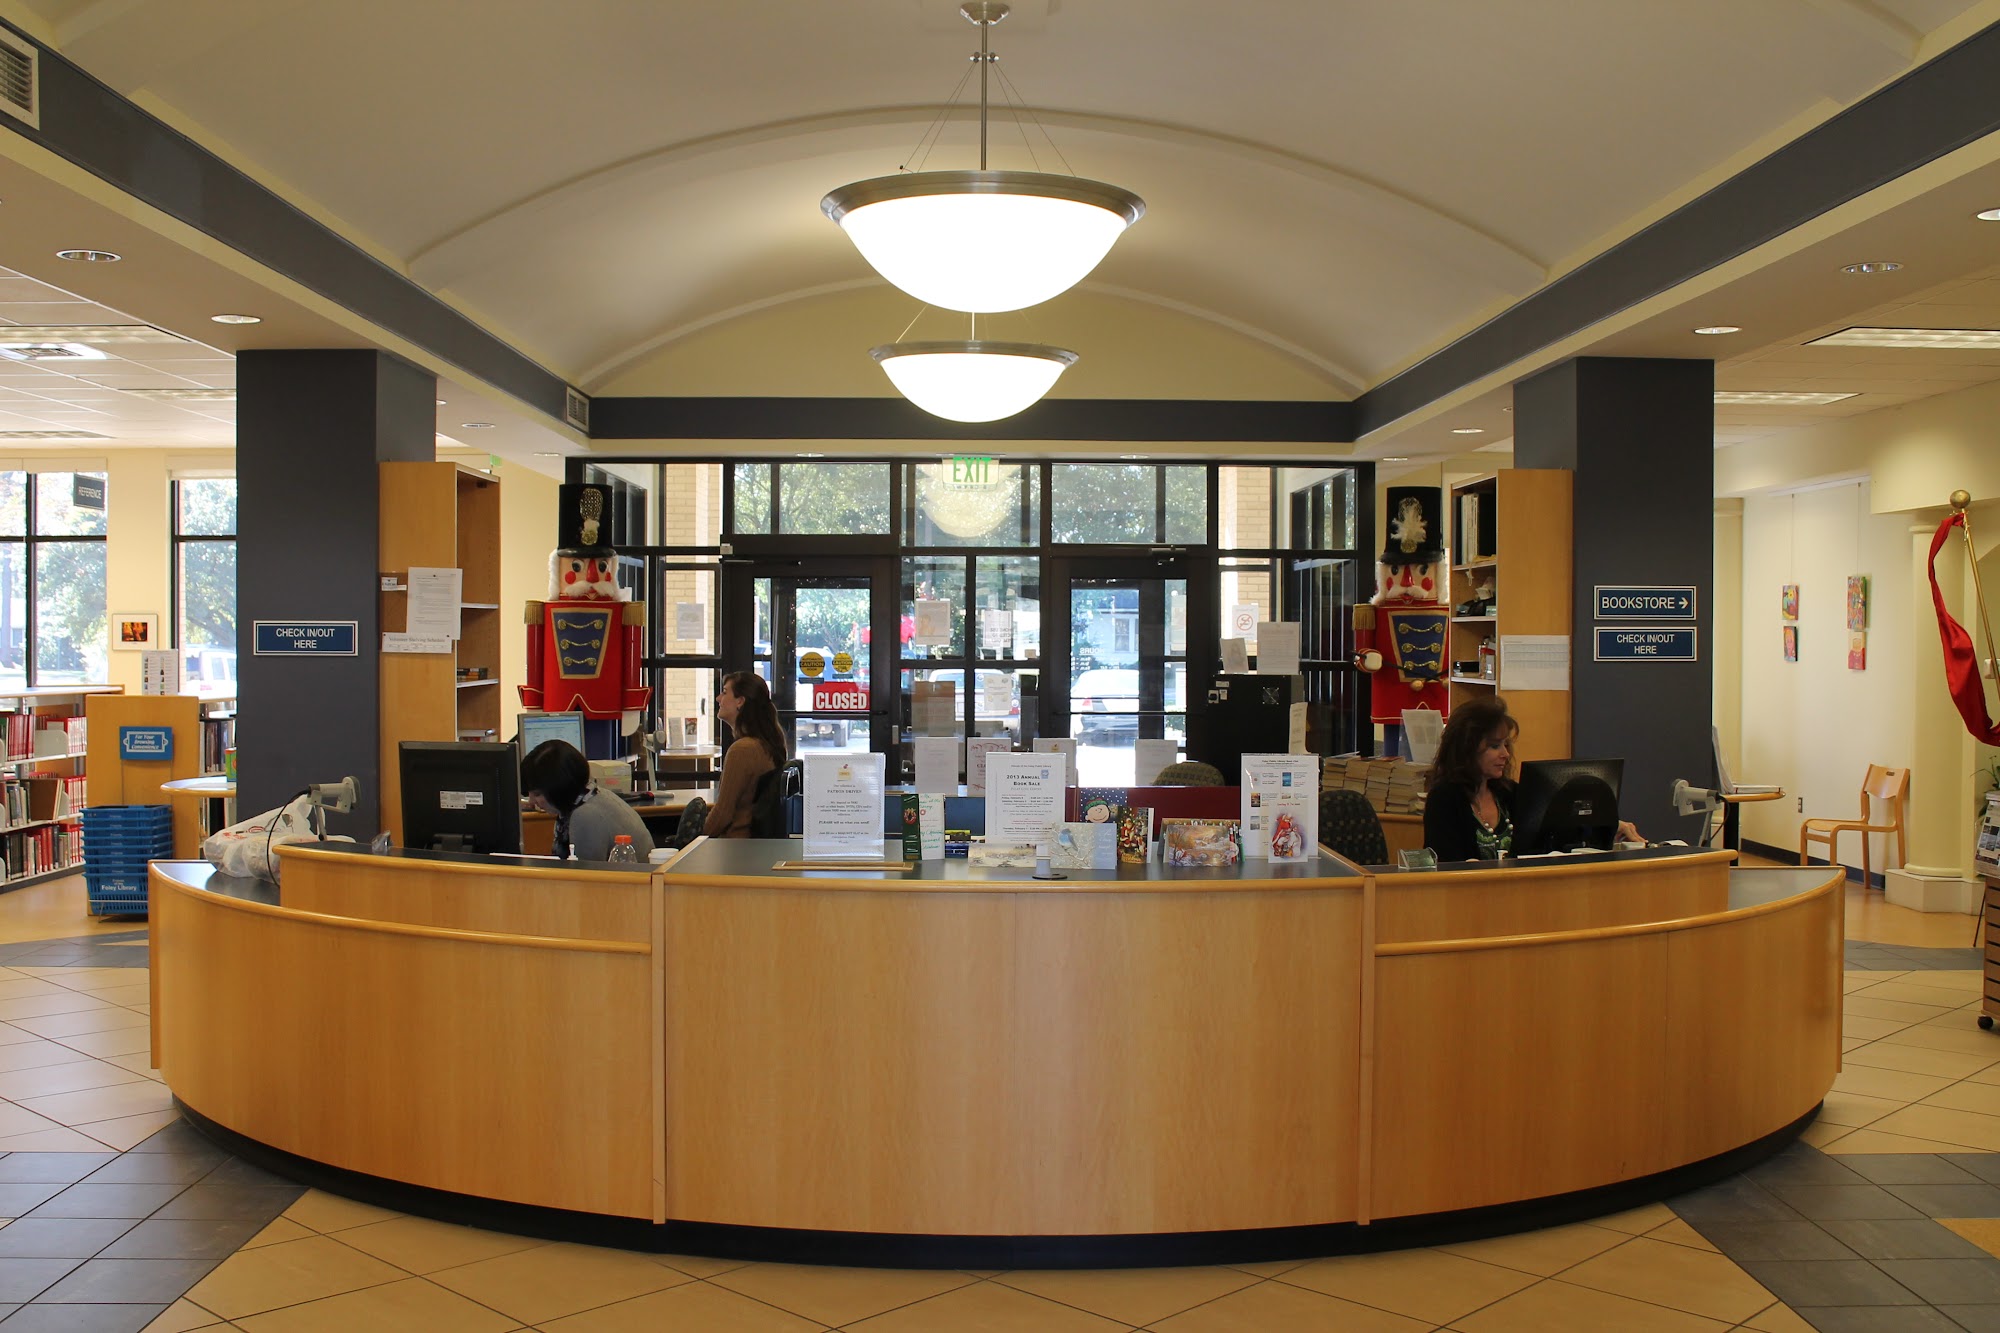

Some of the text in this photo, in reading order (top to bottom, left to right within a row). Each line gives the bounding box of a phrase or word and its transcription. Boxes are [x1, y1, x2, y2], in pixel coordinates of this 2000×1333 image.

[953, 457, 992, 483] EXIT
[1601, 597, 1676, 609] BOOKSTORE
[275, 628, 336, 637] CHECK IN/OUT
[1616, 634, 1675, 643] CHECK IN/OUT
[294, 640, 317, 649] HERE
[1634, 645, 1657, 654] HERE
[815, 692, 867, 709] CLOSED
